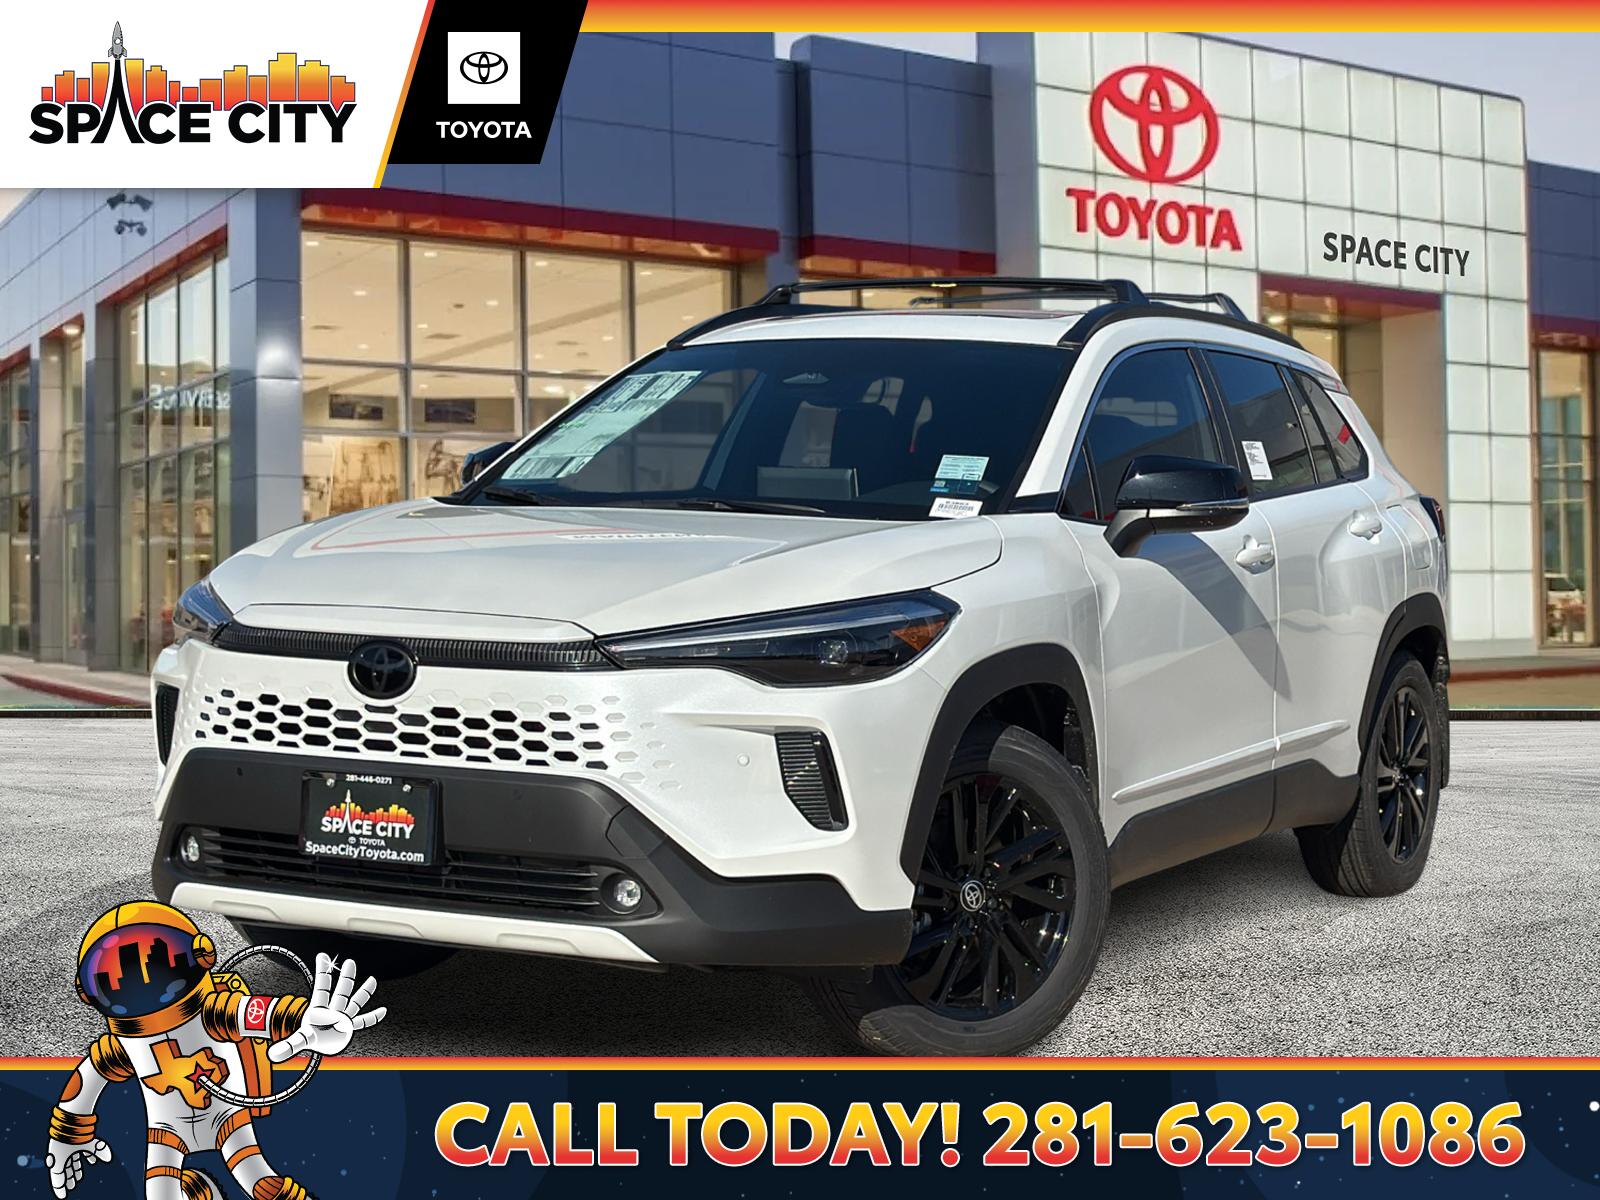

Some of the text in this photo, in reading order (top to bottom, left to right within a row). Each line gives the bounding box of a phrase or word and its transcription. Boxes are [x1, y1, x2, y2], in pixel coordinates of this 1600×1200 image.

[1066, 187, 1243, 251] TOYOTA
[1322, 231, 1471, 277] SPACE CITY
[320, 815, 415, 839] SPACE CITY
[304, 840, 425, 863] SpaceCityToyota.com
[358, 837, 386, 847] TOYOTA
